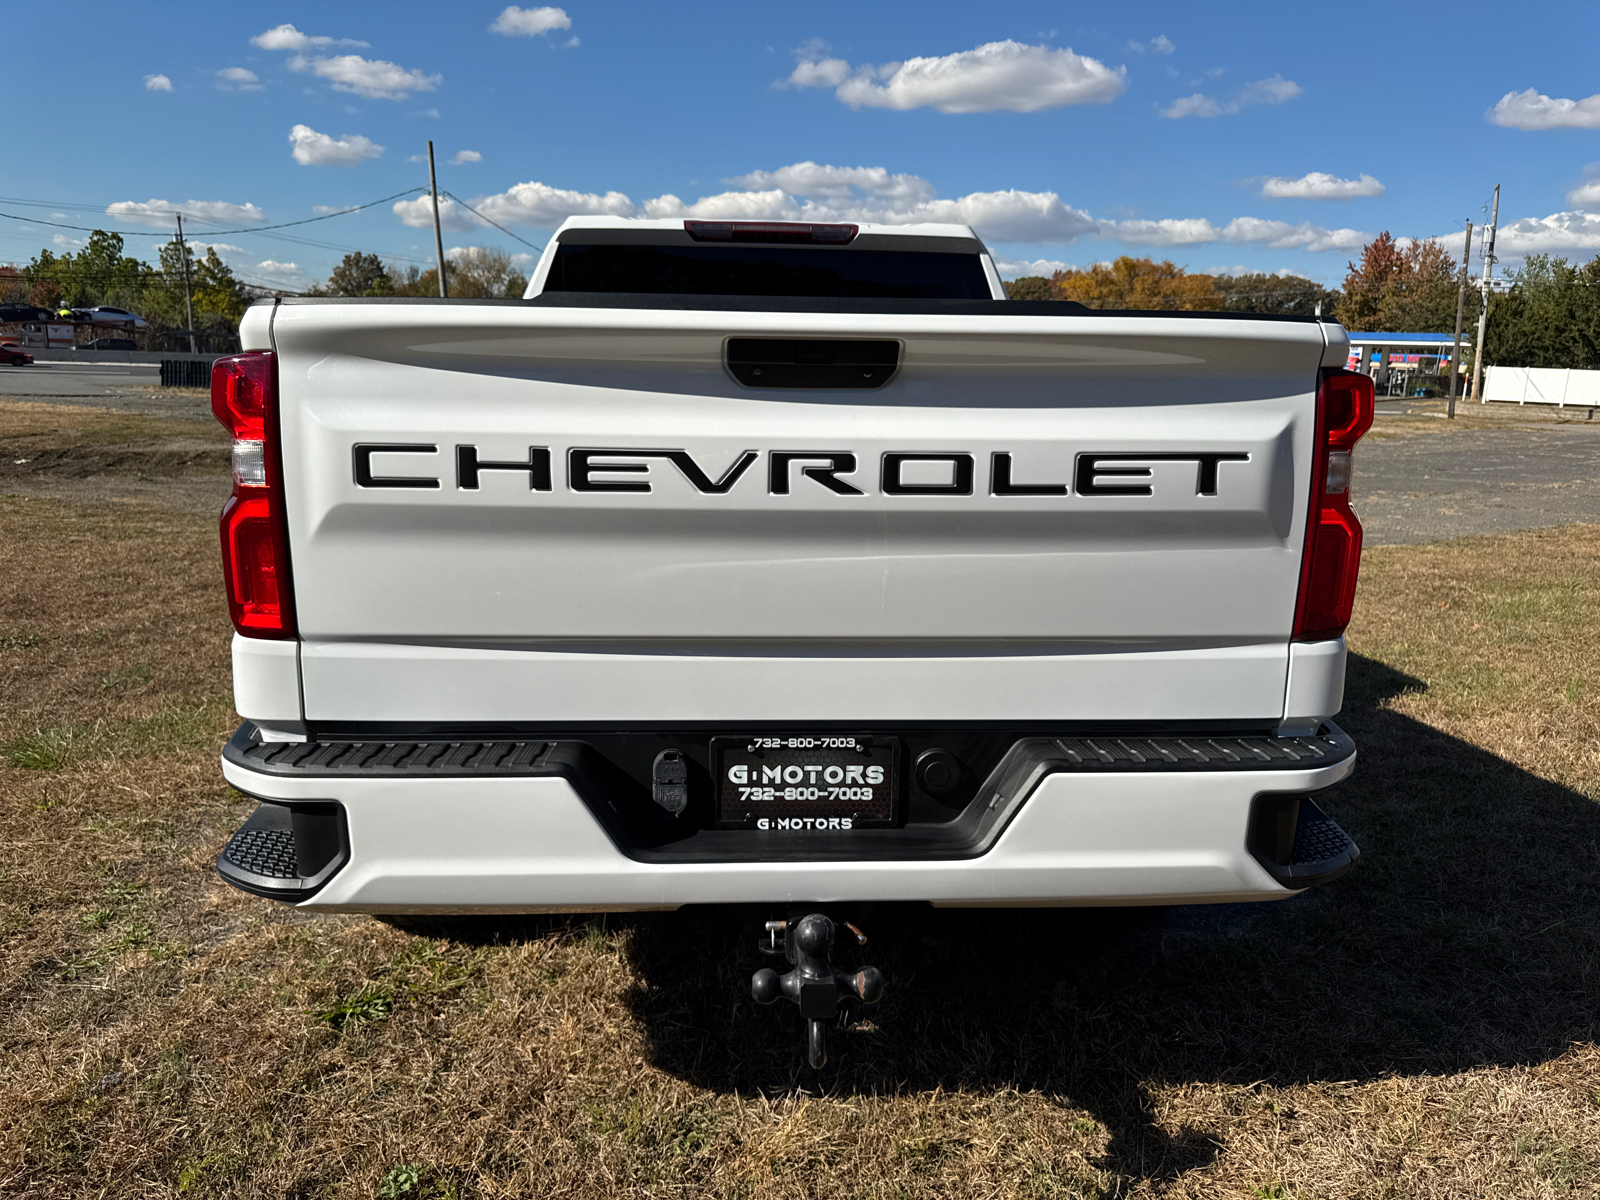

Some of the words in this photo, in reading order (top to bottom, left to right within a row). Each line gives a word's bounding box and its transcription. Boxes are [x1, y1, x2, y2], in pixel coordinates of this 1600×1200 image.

[353, 442, 1249, 497] CHEVROLET
[753, 737, 856, 748] 732-800-7003
[738, 787, 873, 801] 732-800-7003
